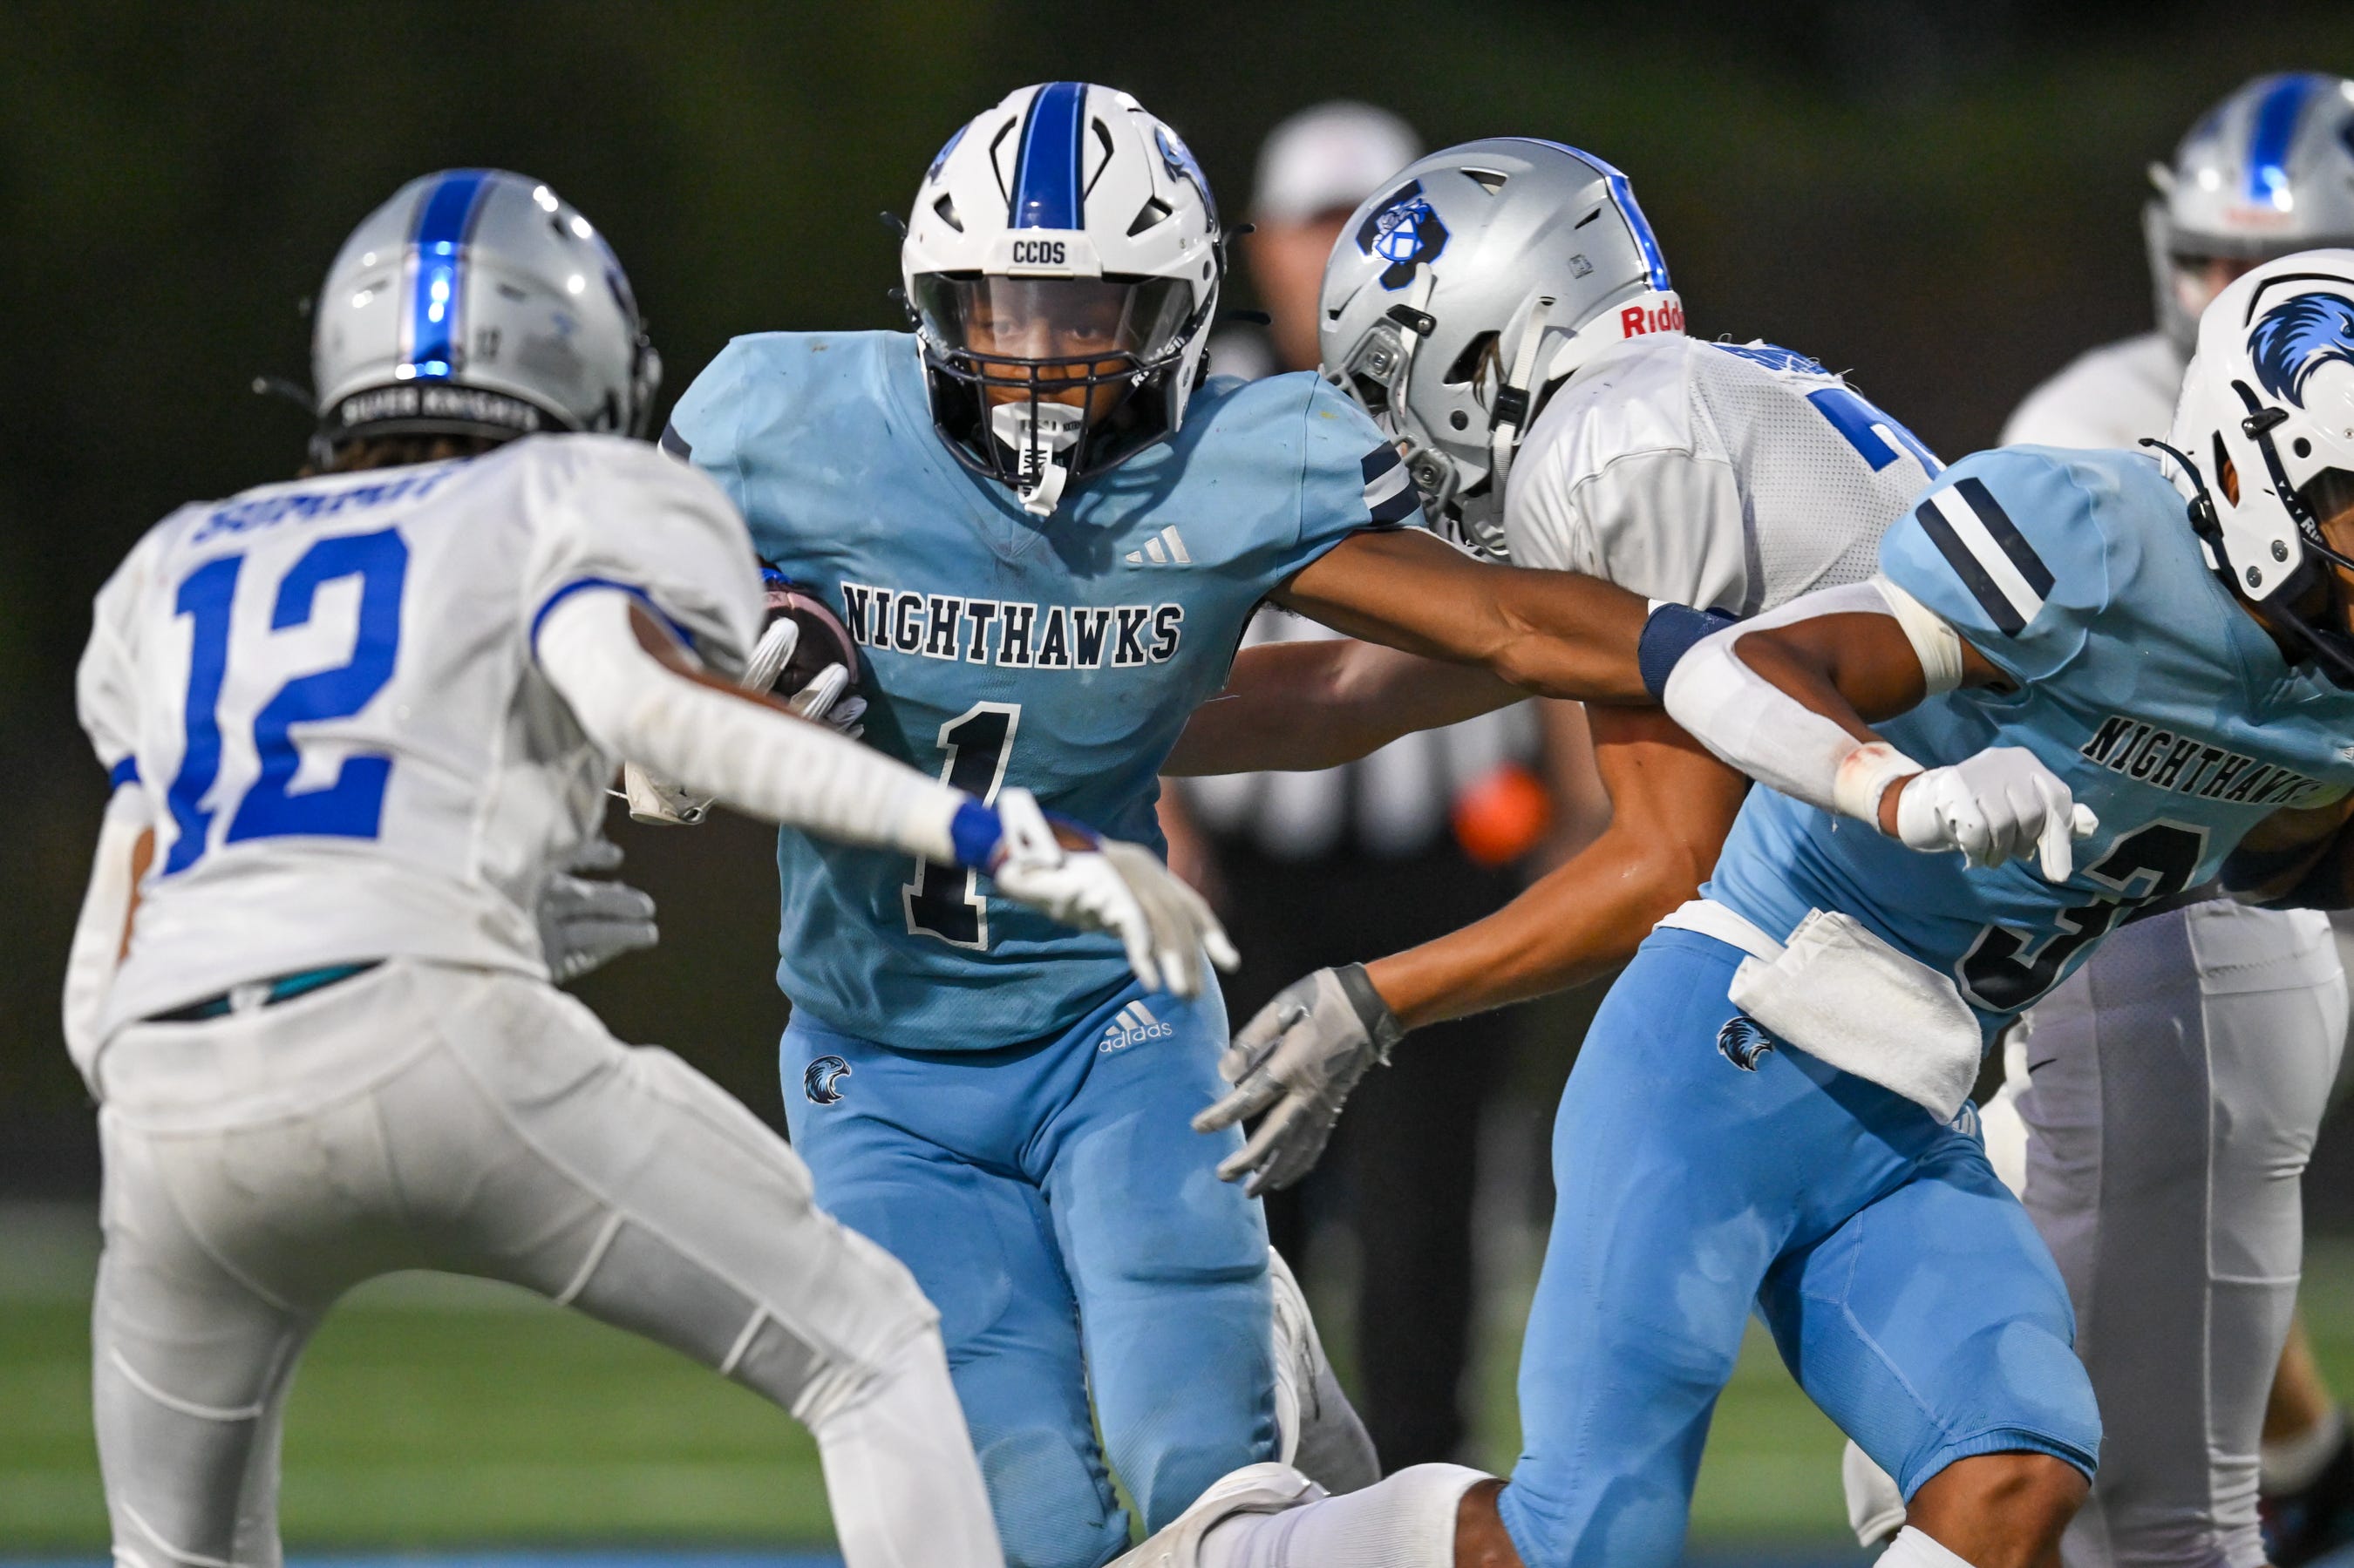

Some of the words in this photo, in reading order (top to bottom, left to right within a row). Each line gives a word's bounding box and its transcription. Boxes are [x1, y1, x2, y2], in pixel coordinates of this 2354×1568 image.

[1013, 240, 1065, 264] CCDS
[840, 580, 1186, 669] NIGHTHAWKS
[160, 526, 410, 879] 12
[901, 701, 1022, 952] 1
[1954, 817, 2211, 1013] 3
[1099, 1022, 1173, 1053] adidas
